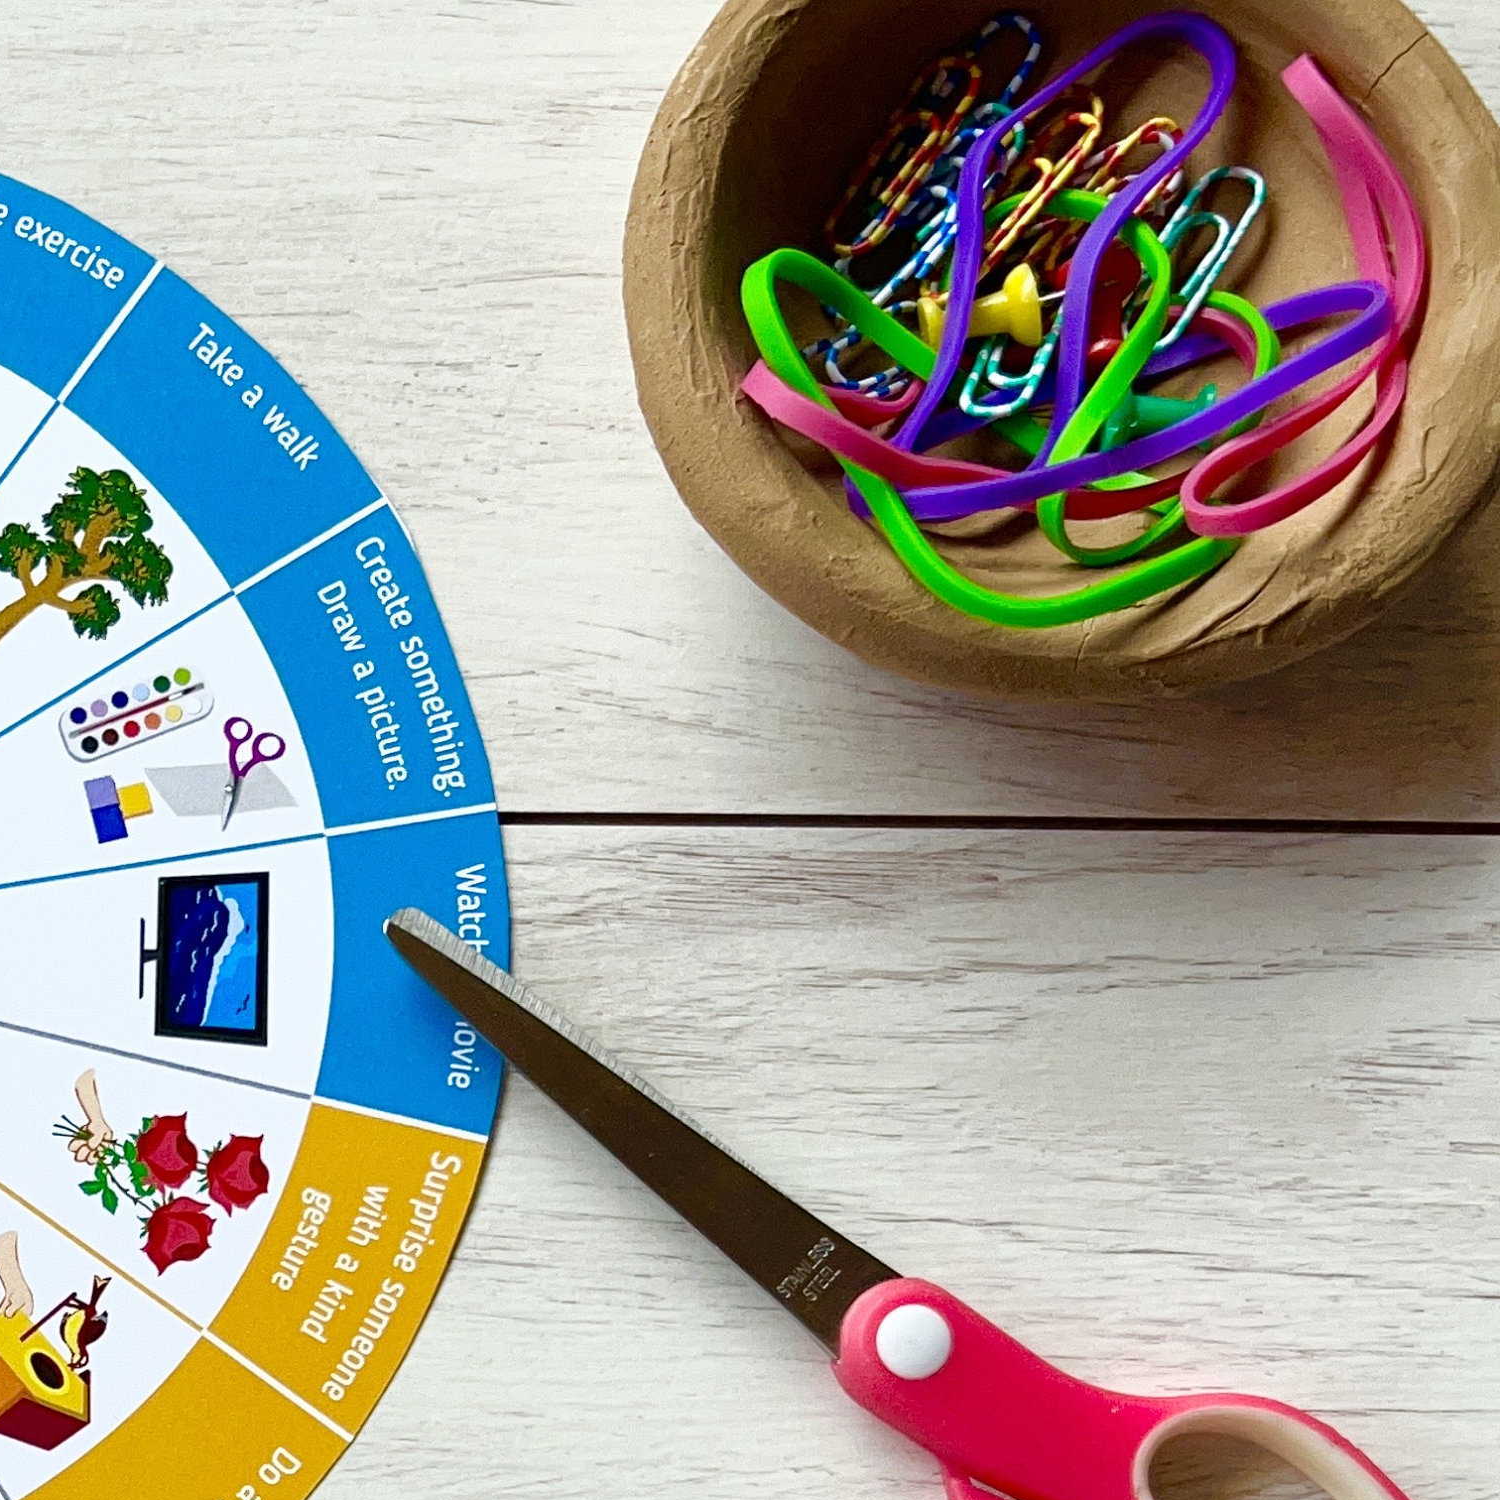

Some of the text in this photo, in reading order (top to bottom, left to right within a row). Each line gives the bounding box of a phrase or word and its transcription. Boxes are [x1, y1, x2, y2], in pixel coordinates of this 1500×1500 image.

[14, 215, 125, 289] exercise
[188, 322, 319, 471] Take a walk
[317, 580, 408, 791] Draw a picture.
[355, 536, 466, 798] Create something.
[447, 1020, 480, 1090] ovie
[271, 1187, 332, 1291] gesture
[300, 1186, 389, 1343] with a kind
[319, 1151, 462, 1401] Surprise someone
[775, 1237, 835, 1299] STAINLESS
[802, 1266, 841, 1302] STEEL
[258, 1446, 302, 1485] Do
